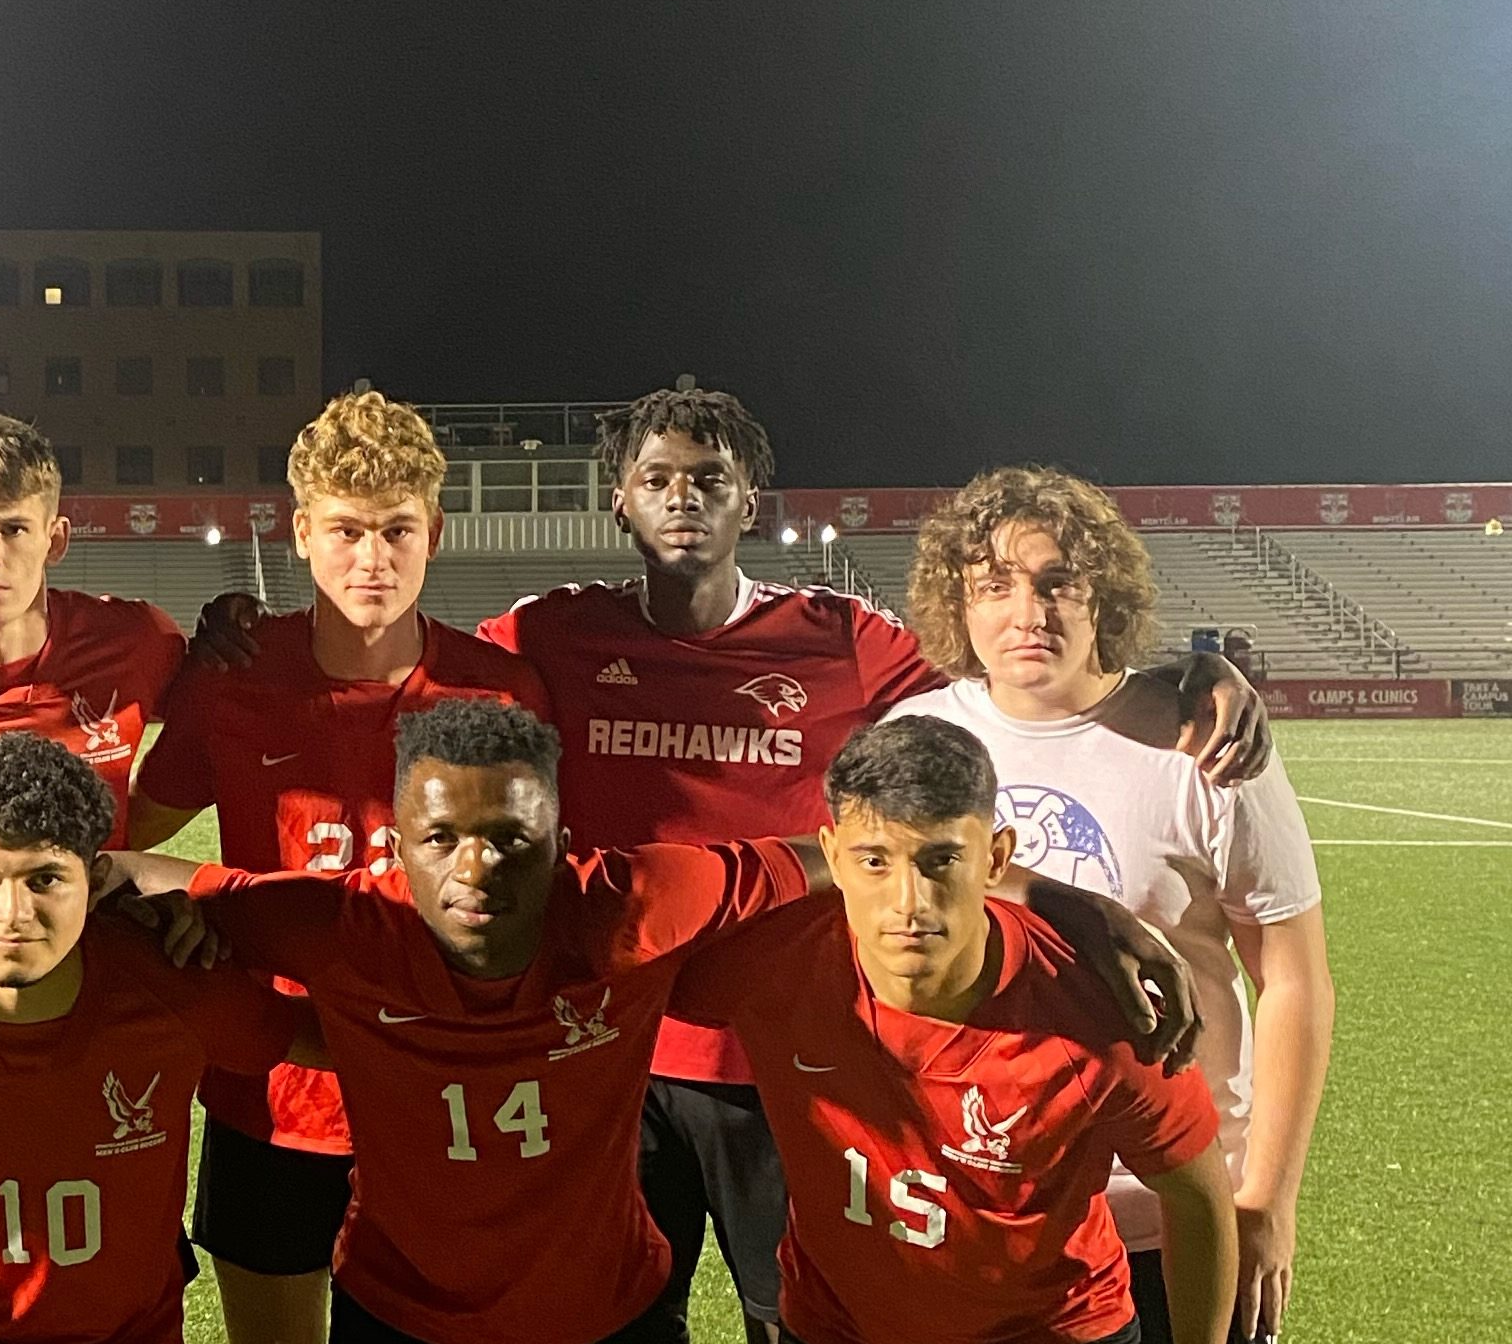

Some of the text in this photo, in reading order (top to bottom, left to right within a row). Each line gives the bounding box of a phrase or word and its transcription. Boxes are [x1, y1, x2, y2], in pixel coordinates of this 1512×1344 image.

[596, 673, 638, 685] adidas
[1491, 681, 1500, 692] A
[1308, 689, 1419, 704] CAMPS & CLINICS
[588, 718, 803, 766] REDHAWKS
[441, 1080, 551, 1161] 14
[844, 1146, 947, 1249] 15
